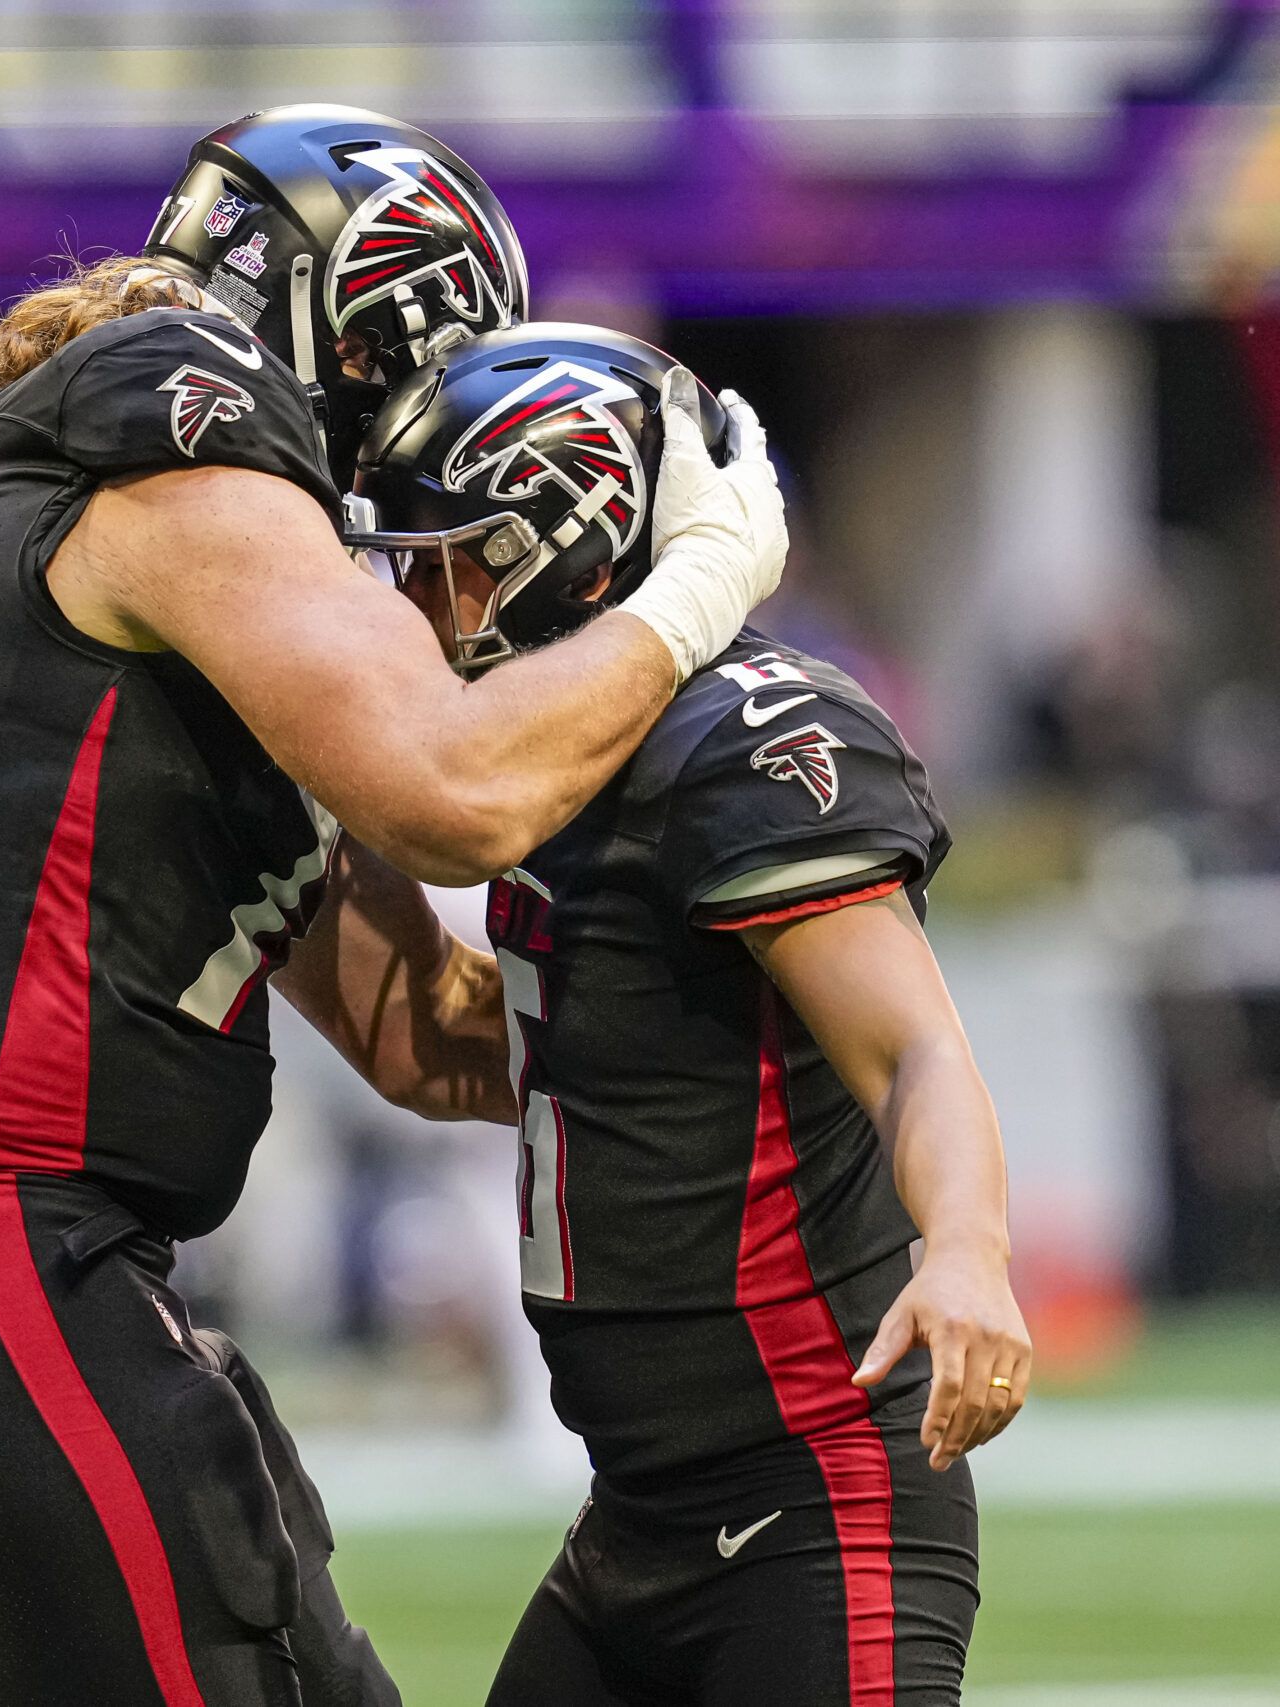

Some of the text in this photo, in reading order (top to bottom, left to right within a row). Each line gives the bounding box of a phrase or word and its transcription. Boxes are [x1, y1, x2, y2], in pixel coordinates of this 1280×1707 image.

[208, 211, 229, 233] NFL
[251, 239, 264, 252] NFL
[229, 249, 265, 274] CATCH
[229, 273, 258, 292] WARNING
